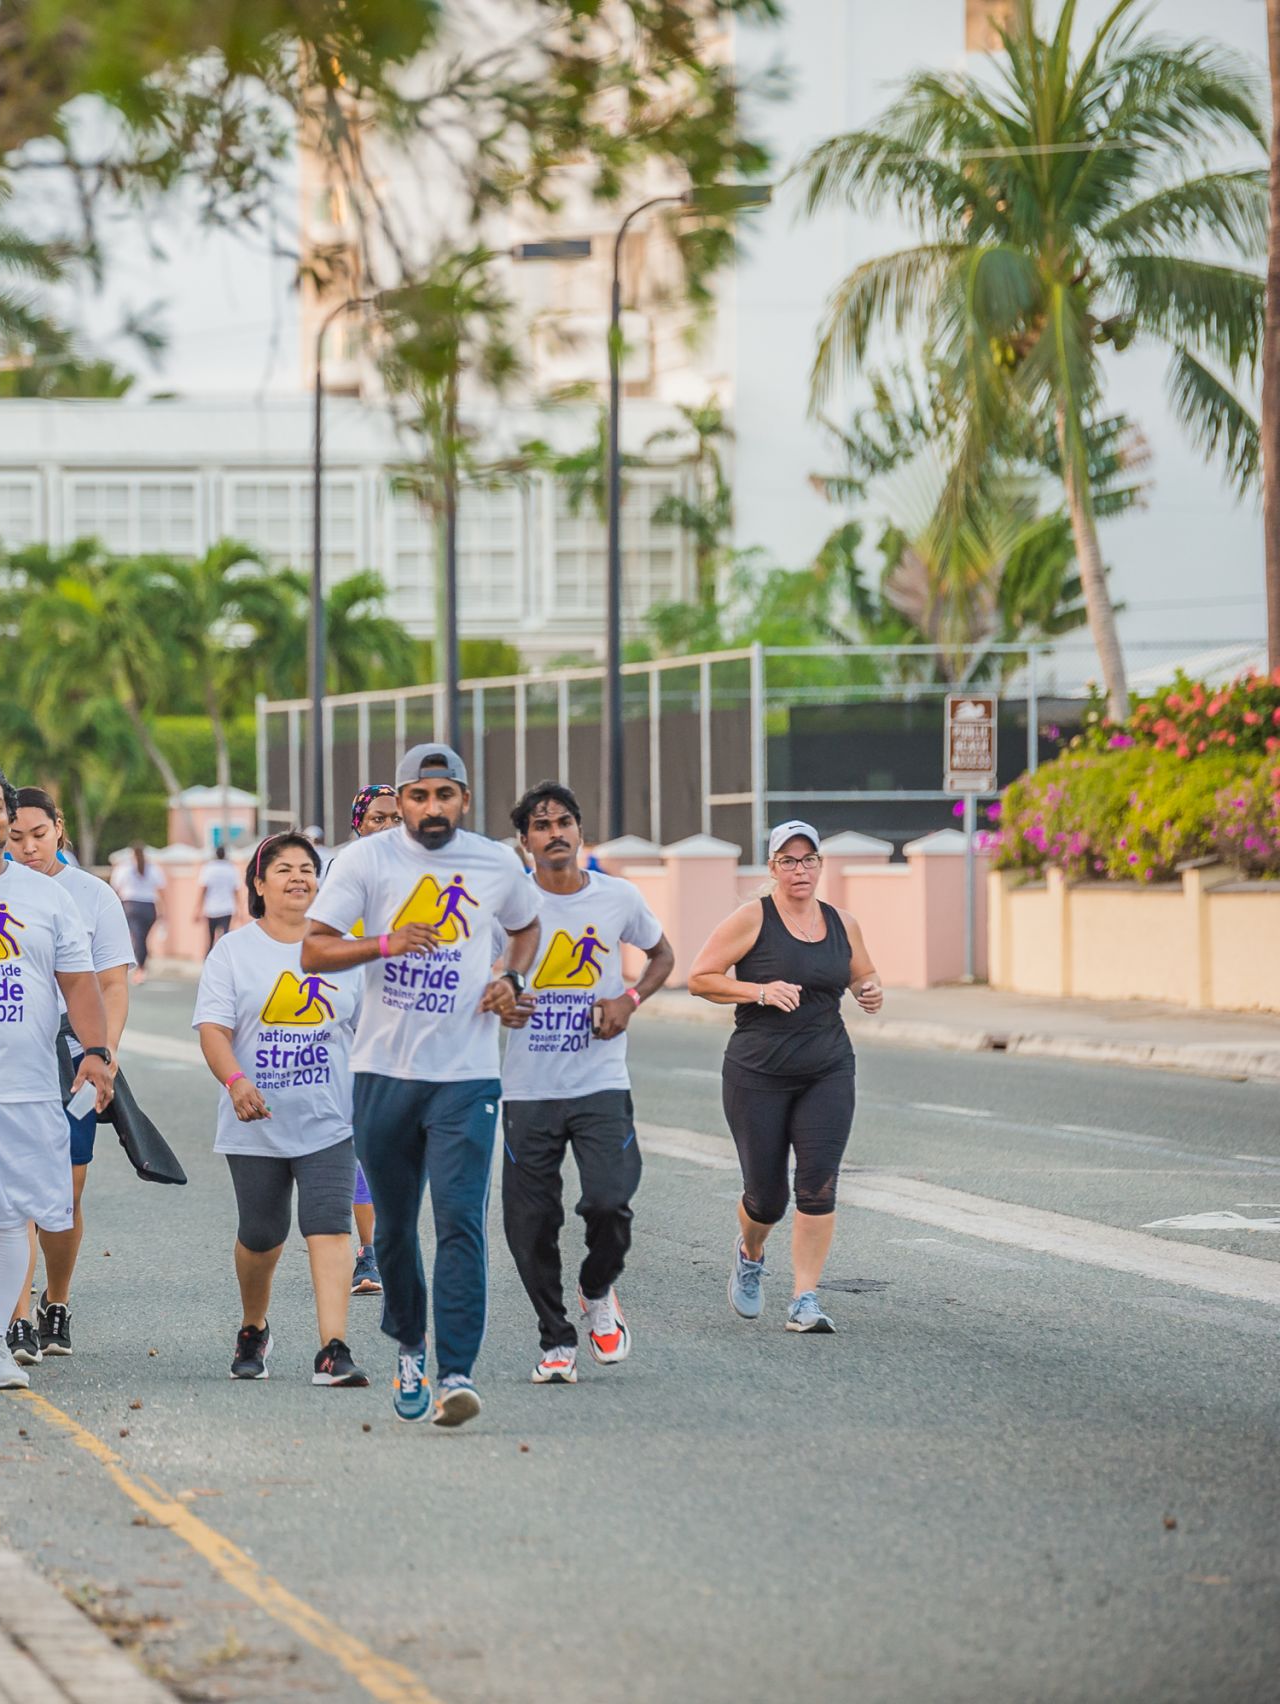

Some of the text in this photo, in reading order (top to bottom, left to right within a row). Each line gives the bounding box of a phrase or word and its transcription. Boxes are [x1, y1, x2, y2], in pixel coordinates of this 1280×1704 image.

[404, 949, 462, 962] ionwide
[384, 960, 460, 990] stride
[382, 991, 456, 1014] cancer 2021
[531, 992, 595, 1006] nationwid
[257, 1029, 331, 1044] nationwide
[528, 1031, 590, 1053] cancer 201
[255, 1044, 329, 1069] stride
[255, 1070, 291, 1080] against
[255, 1066, 330, 1090] cancer 2021
